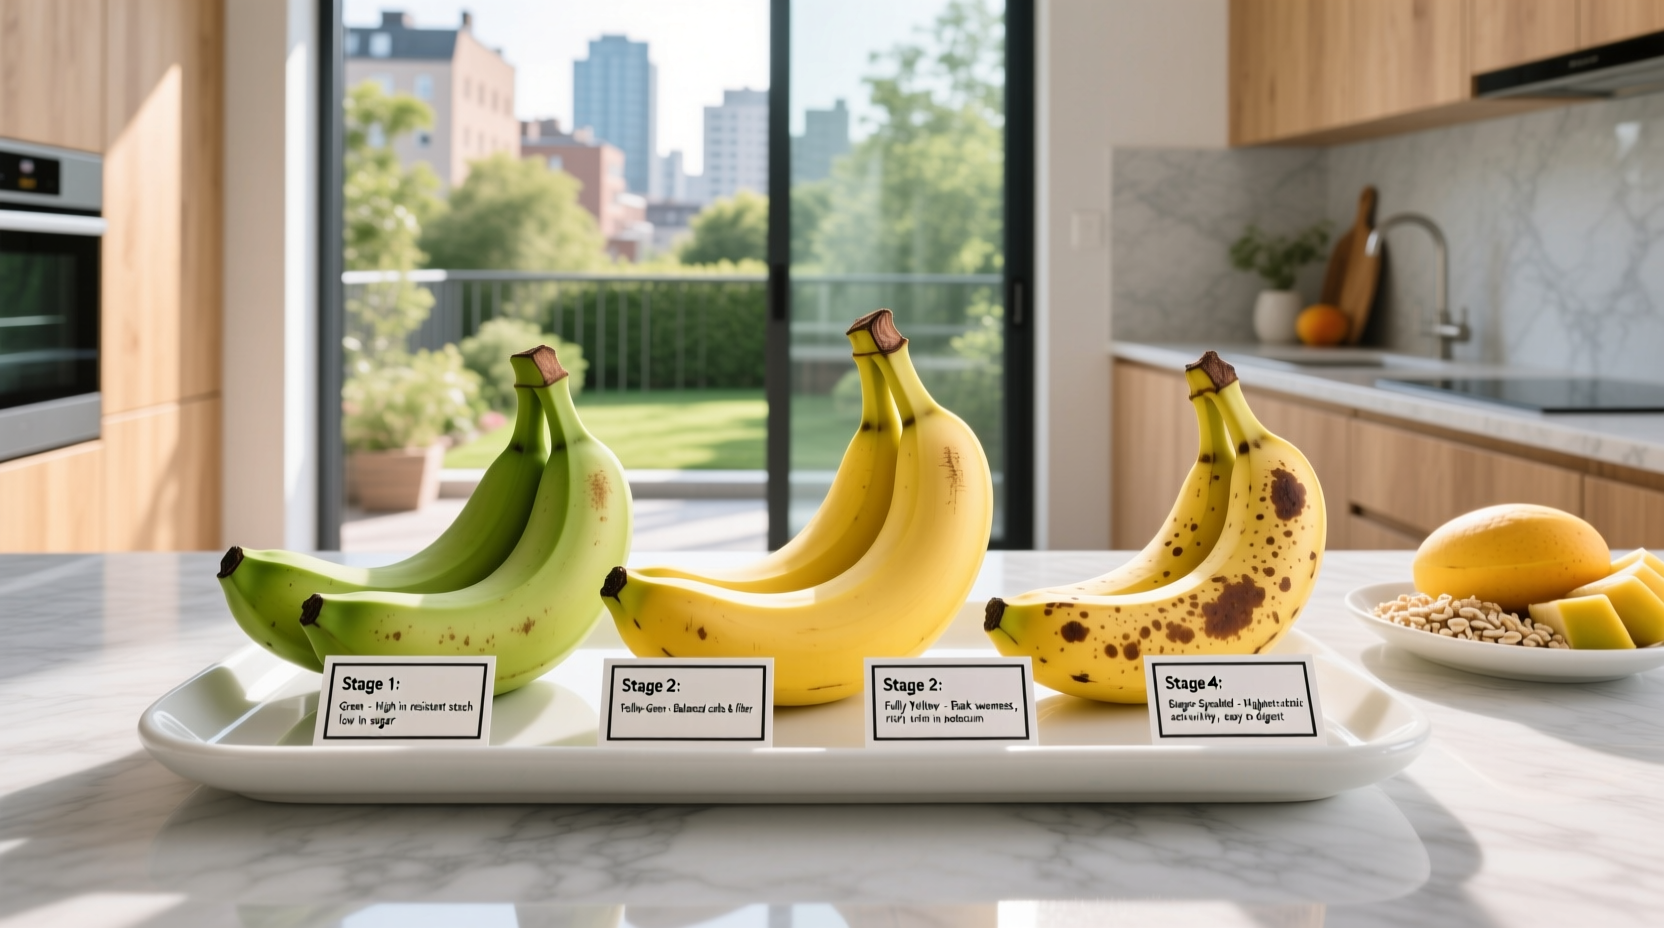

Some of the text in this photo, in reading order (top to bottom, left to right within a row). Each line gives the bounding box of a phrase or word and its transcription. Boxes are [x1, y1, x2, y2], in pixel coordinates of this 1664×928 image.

[342, 676, 400, 694] Stage 1:
[622, 678, 680, 696] Stage 2:
[883, 678, 942, 696] Stage 2:
[1166, 676, 1222, 692] Stage 4:
[885, 700, 906, 714] Fully
